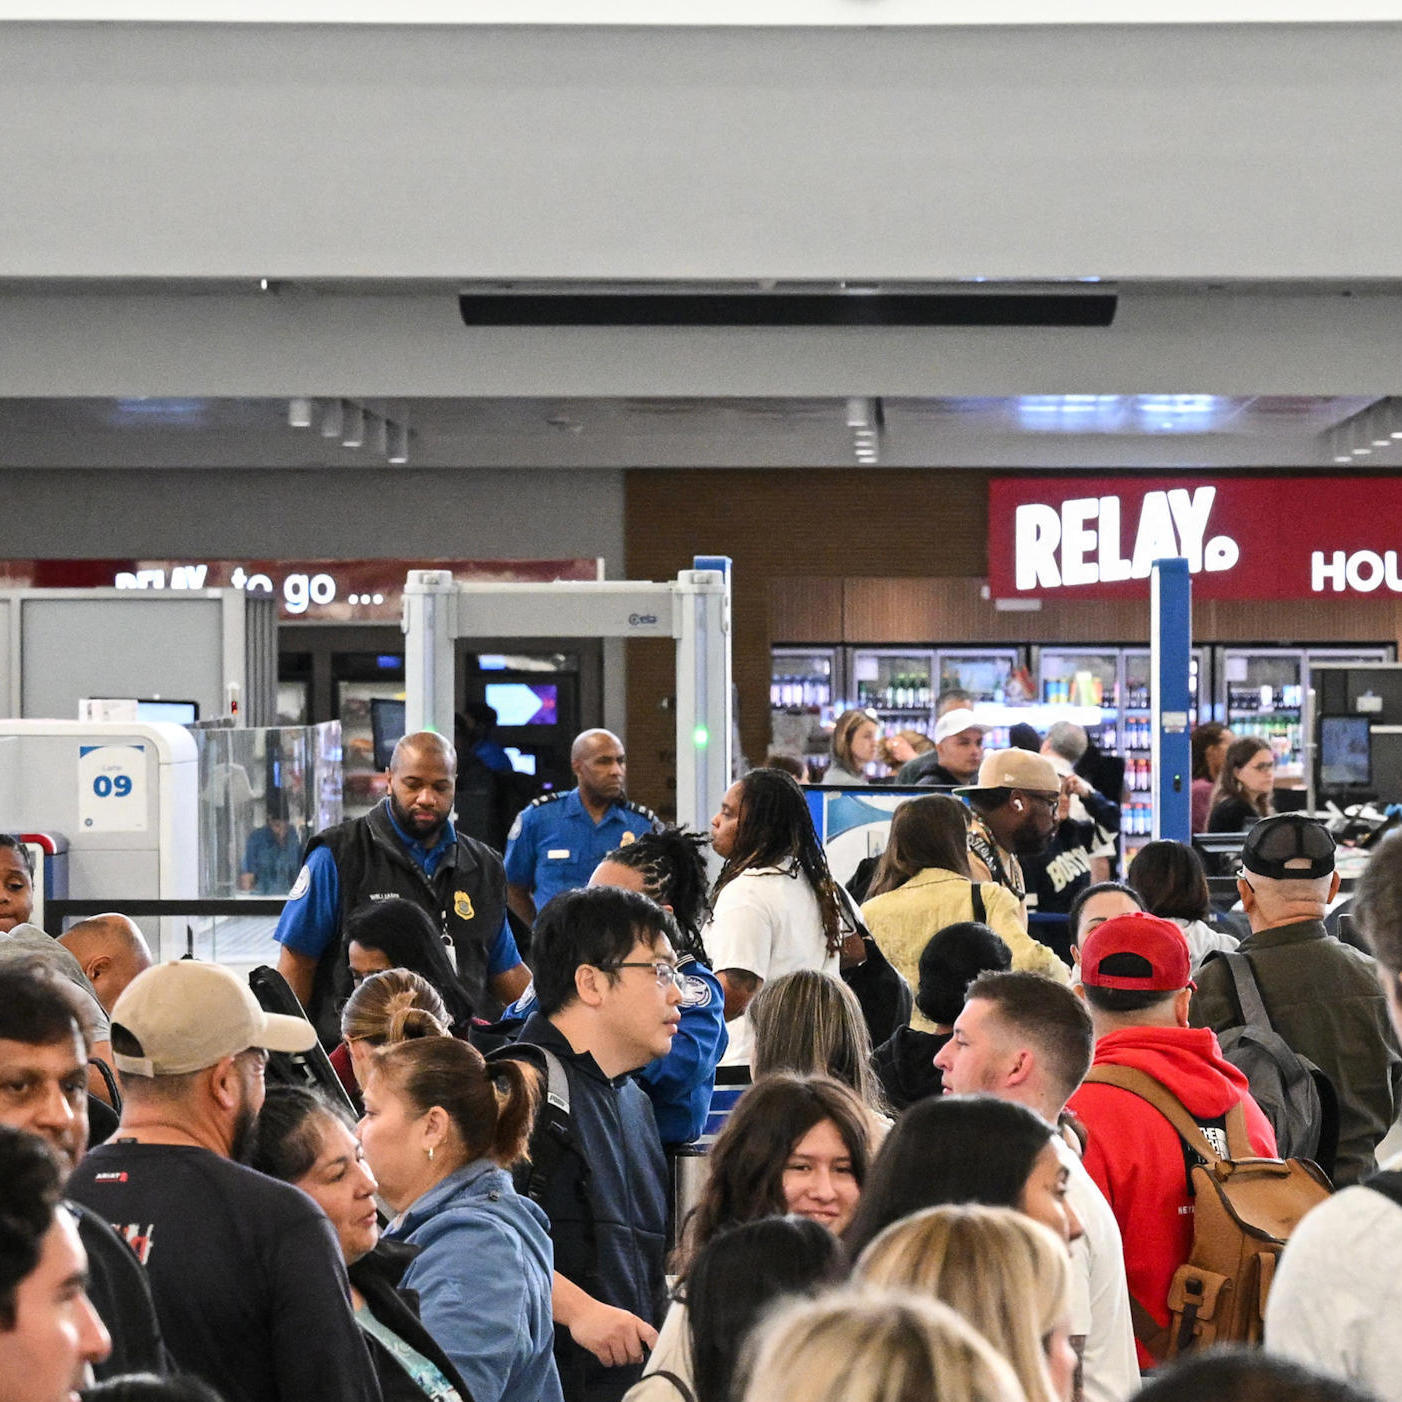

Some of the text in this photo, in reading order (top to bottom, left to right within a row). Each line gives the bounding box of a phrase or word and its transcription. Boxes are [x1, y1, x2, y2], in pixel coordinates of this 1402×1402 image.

[1015, 486, 1217, 590] RELAY
[283, 573, 337, 613] go
[93, 774, 133, 798] 09
